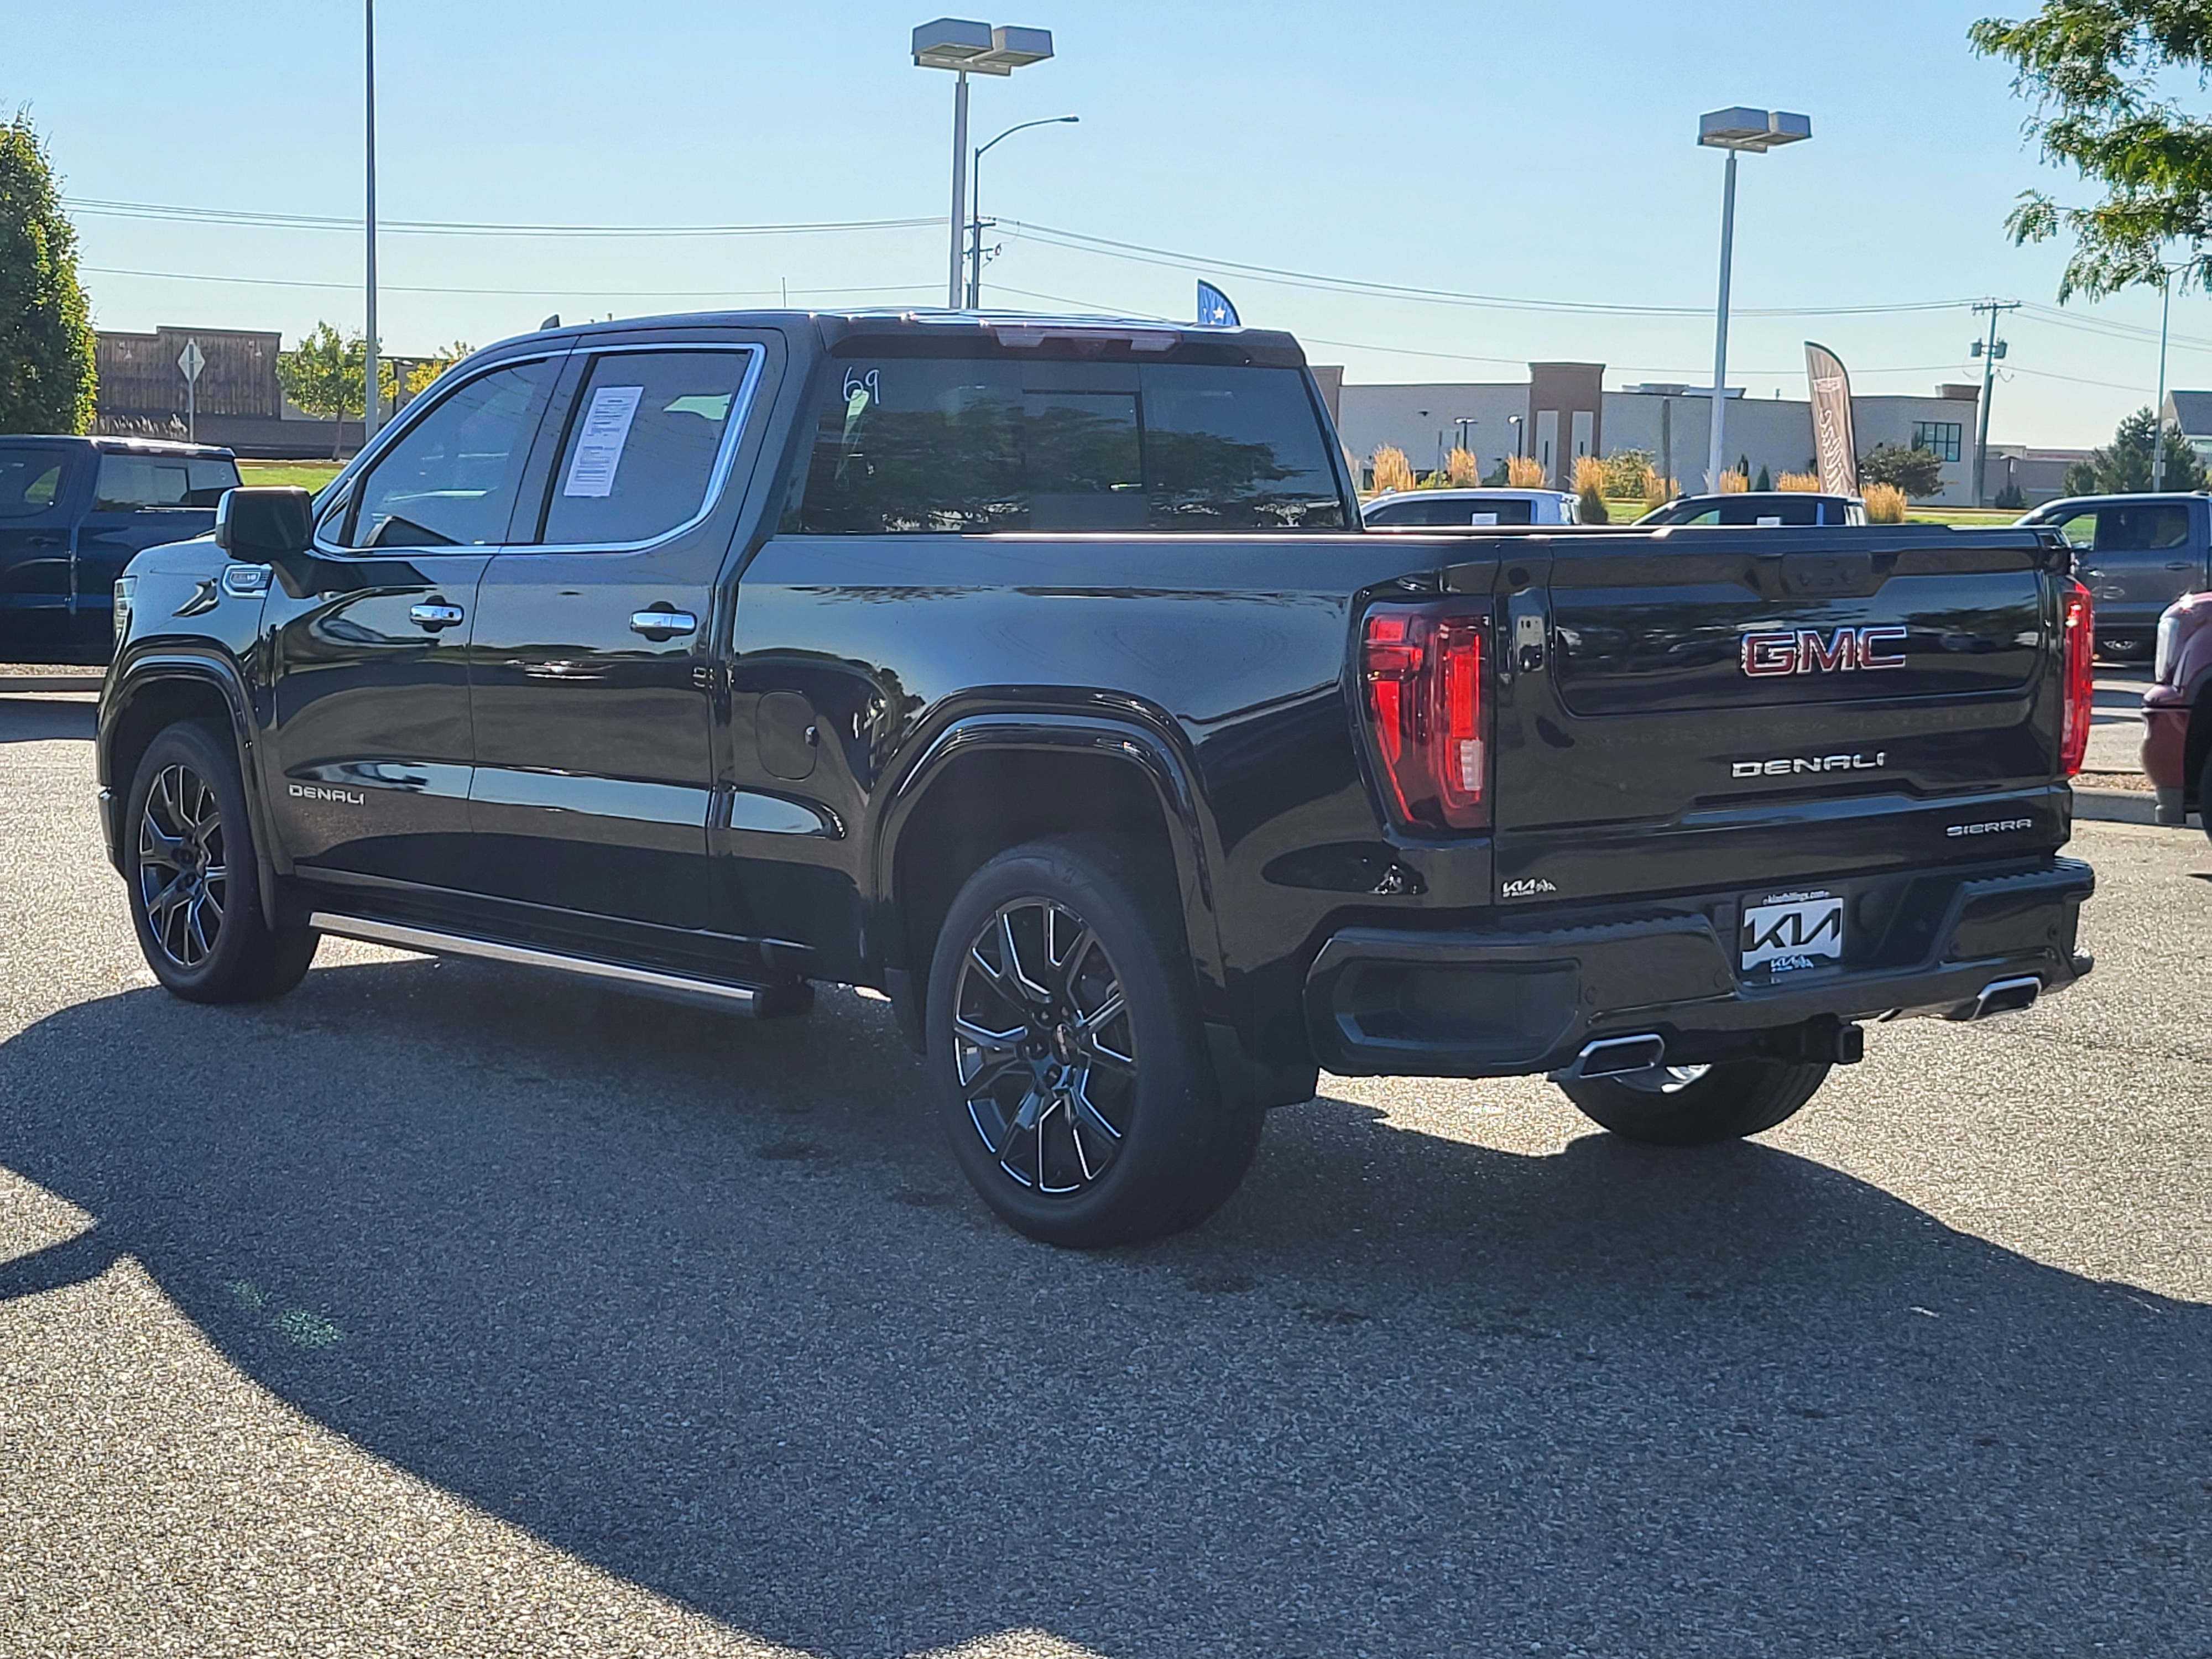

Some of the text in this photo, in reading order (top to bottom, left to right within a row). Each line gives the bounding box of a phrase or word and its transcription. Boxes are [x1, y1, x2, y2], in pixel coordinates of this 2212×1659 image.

[843, 366, 880, 405] 69
[1741, 626, 1907, 676] GMC
[1732, 752, 1885, 778] DENALI
[289, 784, 364, 806] DENALI
[1947, 818, 2032, 837] SIERRA
[1503, 879, 1536, 893] KIA
[1742, 907, 1841, 952] KIA
